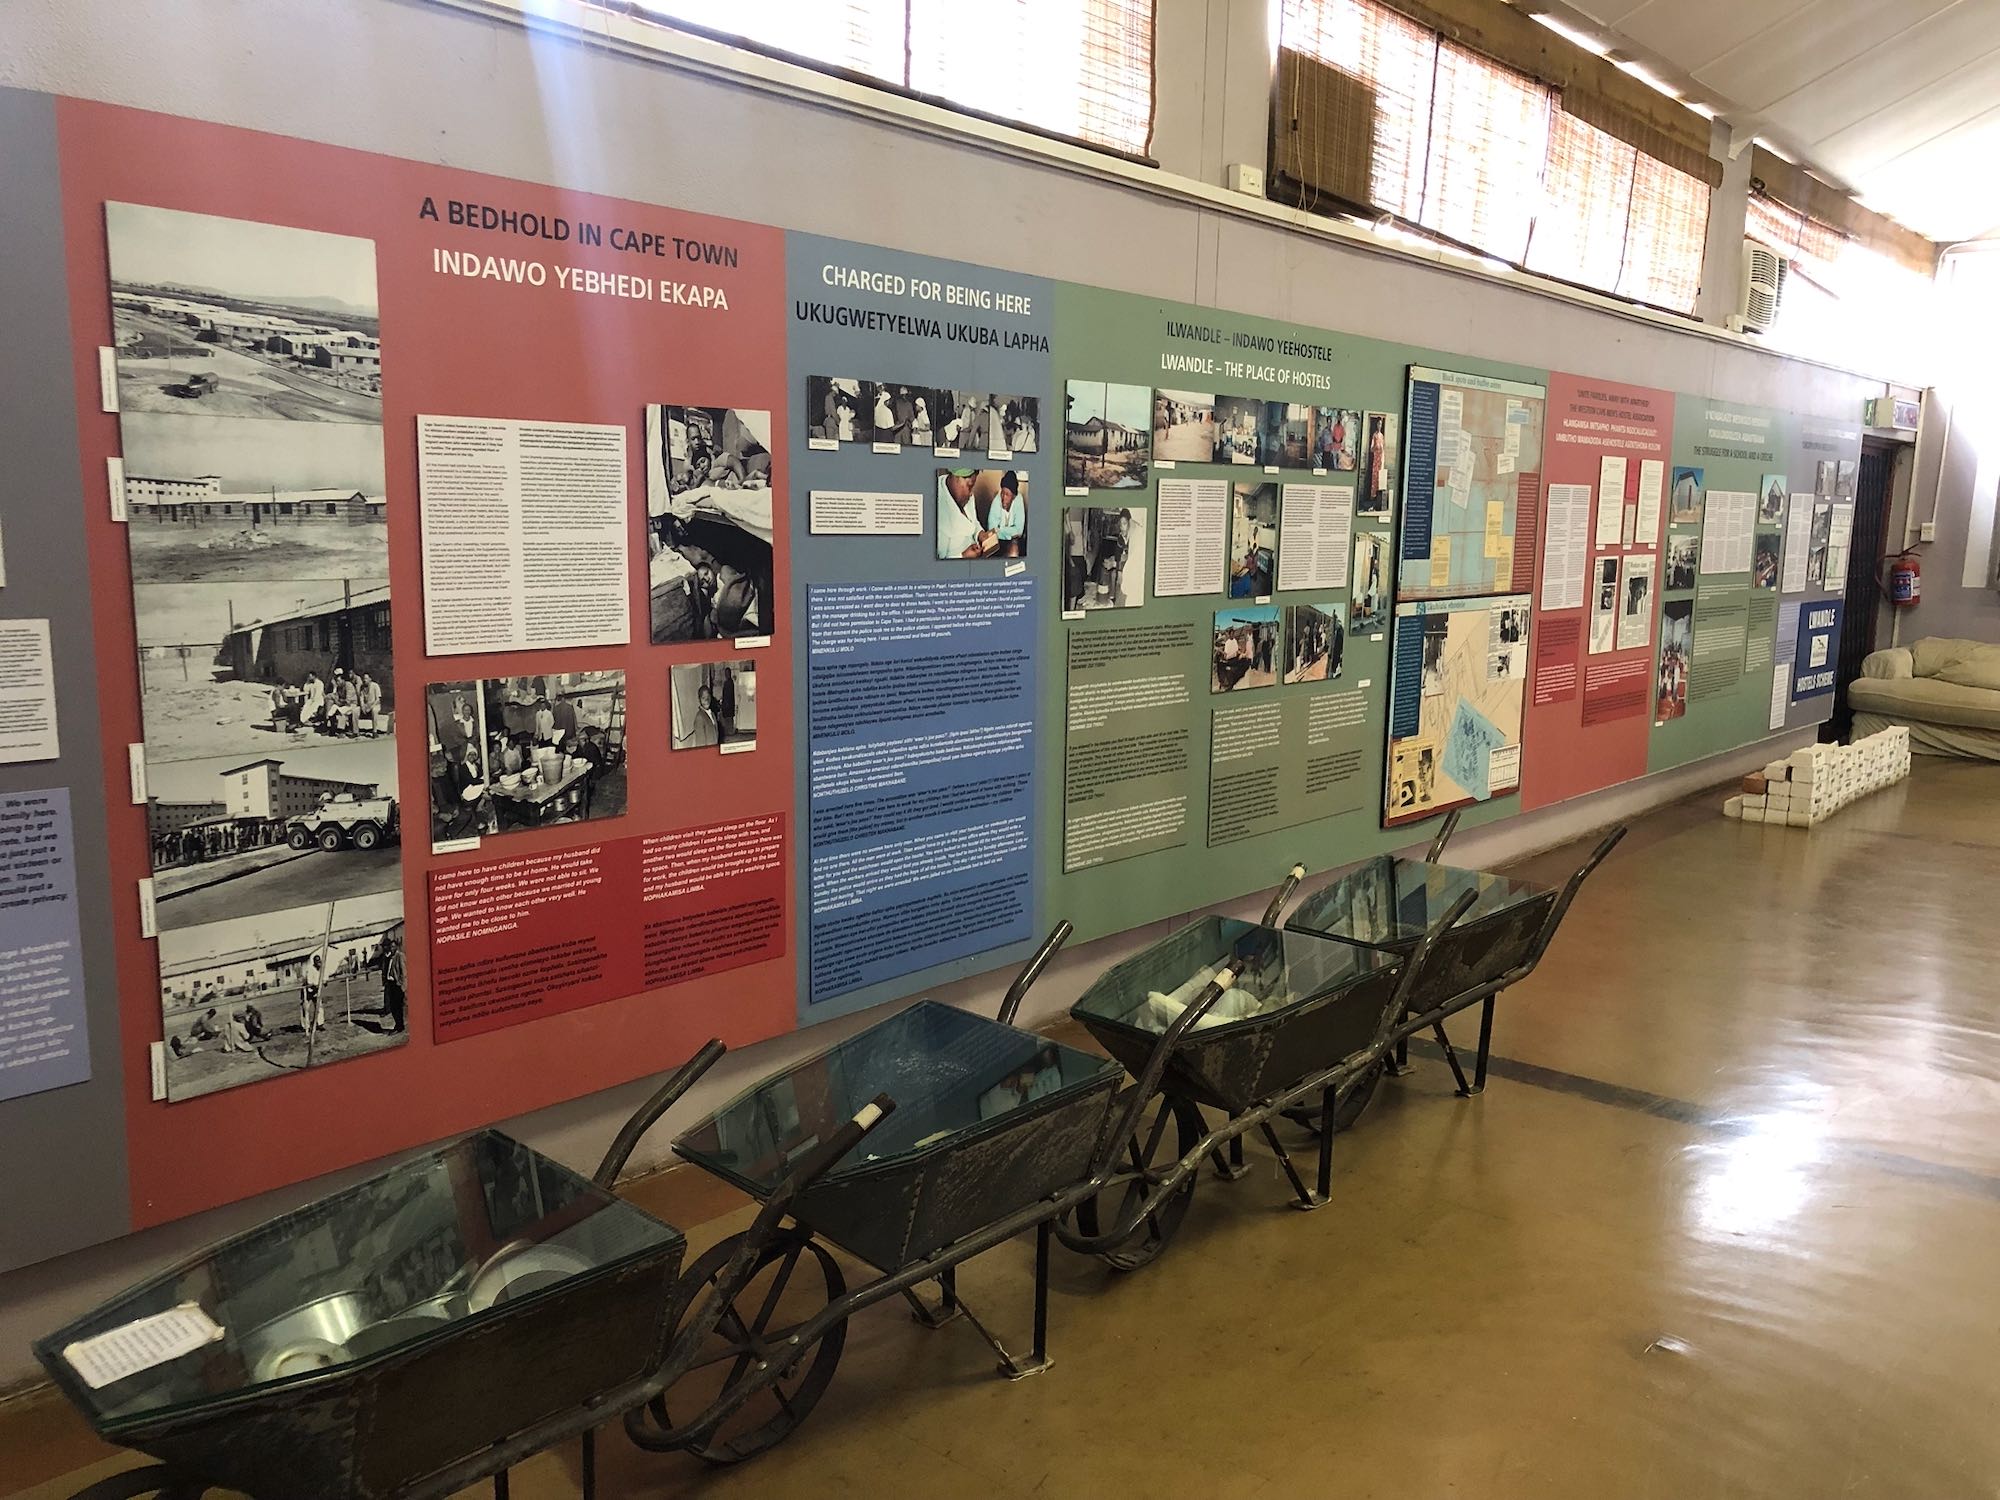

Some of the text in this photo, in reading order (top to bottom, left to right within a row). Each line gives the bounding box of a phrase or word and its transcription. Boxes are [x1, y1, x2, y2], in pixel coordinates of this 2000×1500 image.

[419, 197, 738, 268] A BEDHOLD IN CAPE TOWN
[434, 248, 729, 310] INDAWO YEBHEDI EKAPA
[822, 264, 1032, 316] CHARGED FOR BEING HERE
[796, 300, 1050, 353] UKUGWETYELWA UKUBA LAPHA
[1166, 321, 1222, 344] ILWANDLE
[1232, 332, 1274, 352] INDAWO
[1278, 340, 1332, 362] YEEHOSTELE
[1161, 353, 1213, 374] LWANDLE
[1224, 361, 1244, 378] THE
[1246, 364, 1276, 383] PLACE
[1278, 368, 1290, 384] OF
[1292, 370, 1331, 390] HOSTELS
[1808, 608, 1835, 629] LWANDLE
[1796, 674, 1816, 692] HOSTELS
[37, 821, 52, 830] get
[31, 846, 47, 856] put
[438, 872, 456, 880] came
[498, 861, 524, 870] children
[525, 856, 551, 865] because
[563, 848, 590, 858] husband
[464, 876, 489, 886] enough
[560, 860, 579, 869] would
[495, 882, 515, 890] weeks.
[435, 904, 446, 912] did
[478, 896, 494, 904] each
[495, 893, 512, 901] other
[513, 888, 540, 897] because
[551, 881, 575, 890] married
[582, 877, 601, 886] young
[463, 907, 487, 917] wanted
[495, 903, 513, 911] know
[514, 900, 529, 908] each
[563, 890, 575, 898] well.
[436, 923, 460, 933] wanted
[490, 915, 508, 923] close
